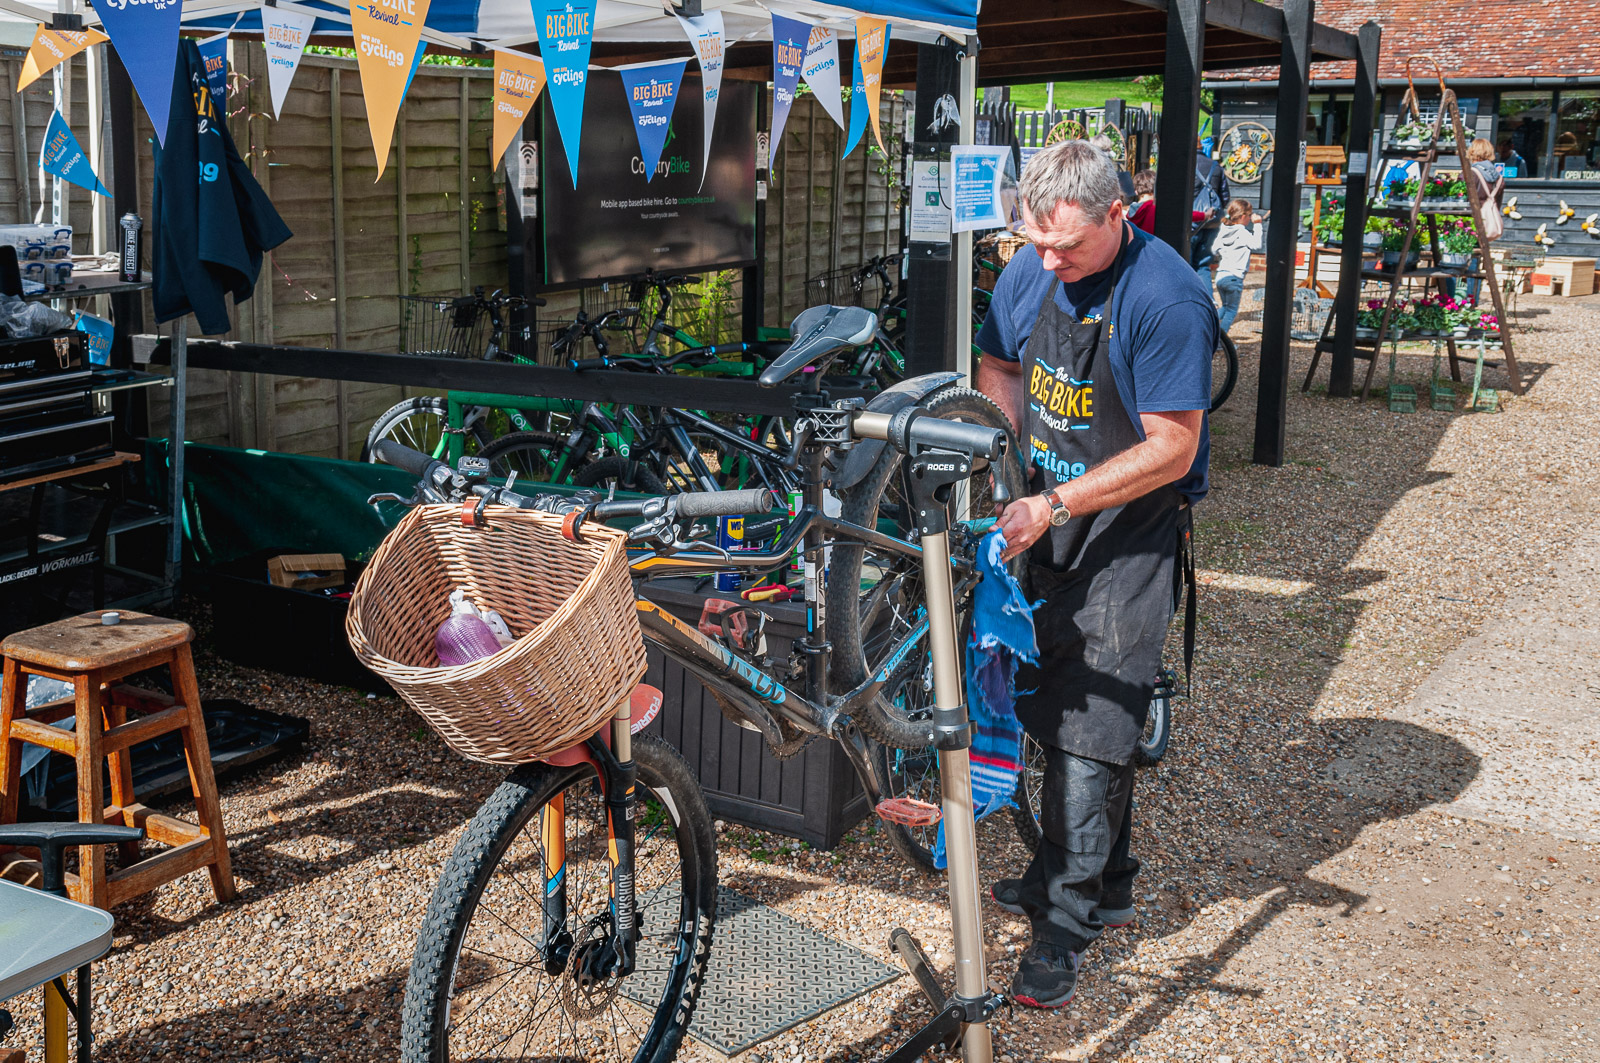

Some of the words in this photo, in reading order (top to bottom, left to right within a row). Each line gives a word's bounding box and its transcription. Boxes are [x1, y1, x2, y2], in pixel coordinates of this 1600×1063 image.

[368, 4, 400, 26] Revival
[546, 14, 565, 38] BIG
[567, 12, 589, 37] BIKE
[269, 26, 282, 40] BIG
[283, 30, 302, 44] BIKE
[361, 34, 370, 42] we
[361, 41, 404, 66] cycling
[557, 38, 580, 52] Revival
[205, 56, 224, 72] BIKE
[271, 58, 294, 68] cycling
[778, 44, 788, 65] BIG
[788, 46, 802, 67] BIKE
[806, 58, 834, 76] cycling
[498, 72, 514, 87] BIG
[514, 76, 536, 93] BIKE
[553, 69, 584, 85] cycling
[634, 86, 650, 100] BIG
[652, 83, 673, 98] BIKE
[777, 91, 792, 103] cycling
[639, 116, 666, 126] cycling
[50, 130, 68, 152] BIKE
[62, 152, 81, 175] cycling
[1565, 170, 1581, 179] OPEN
[601, 200, 617, 208] Mobile
[618, 200, 628, 209] app
[629, 199, 642, 207] based
[643, 198, 653, 206] bike
[654, 198, 664, 206] hire.
[665, 197, 672, 205] Go
[127, 244, 135, 270] PROTECT
[1055, 367, 1069, 382] The
[1030, 365, 1053, 404] BIG
[1049, 382, 1093, 417] BIKE
[1040, 403, 1069, 432] Revival
[1031, 445, 1085, 479] ycling
[1056, 473, 1070, 482] UK
[41, 552, 96, 573] WORKMATE
[619, 873, 632, 930] ROCKSHOX
[675, 915, 709, 1026] MAXXIS
